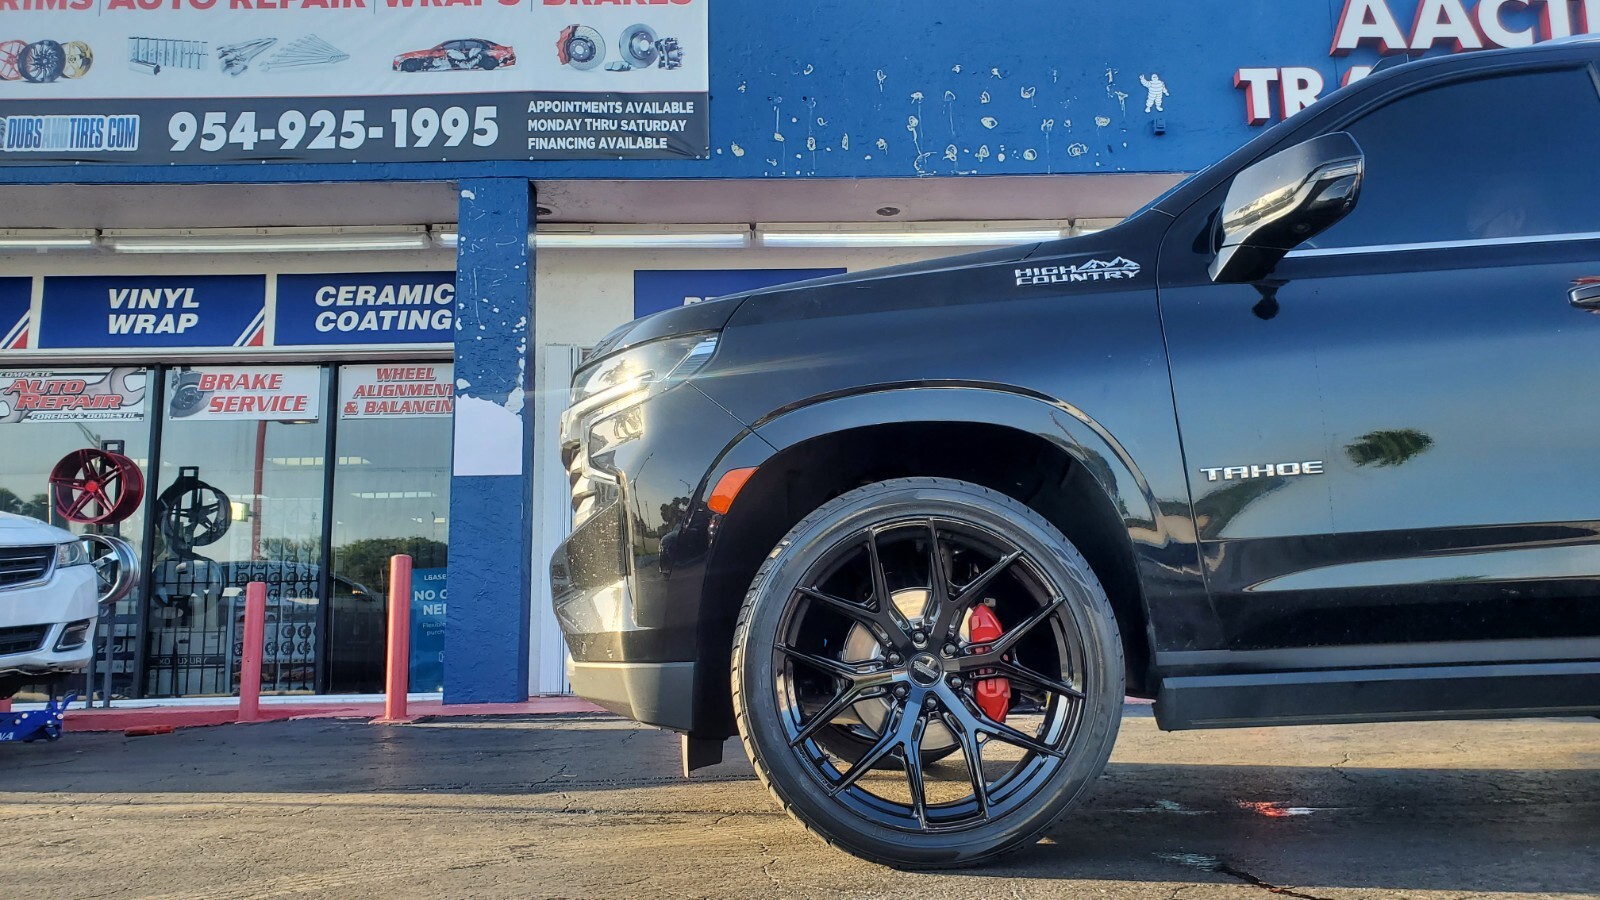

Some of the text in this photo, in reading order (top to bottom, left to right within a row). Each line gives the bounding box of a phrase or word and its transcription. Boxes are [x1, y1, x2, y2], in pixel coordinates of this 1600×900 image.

[527, 101, 694, 114] APPOINTMENTS AVAILABLE
[168, 106, 499, 151] 954-925-1995
[527, 119, 687, 132] MONDAY THRU SATURDAY
[527, 137, 668, 150] FINANCING AVAILABLE
[1014, 265, 1077, 278] HIGH
[1016, 269, 1140, 286] COUNTRY
[108, 288, 200, 309] VINYL
[315, 283, 455, 307] CERAMIC
[108, 313, 199, 334] WRAP
[315, 309, 453, 332] COATING
[198, 373, 283, 391] BRAKE
[376, 367, 437, 382] WHEEL
[3, 379, 86, 395] AUTO
[14, 394, 123, 410] REPAIR
[208, 395, 308, 413] SERVICE
[343, 401, 359, 415] &
[1200, 460, 1324, 481] TAHOE
[414, 589, 436, 601] NO
